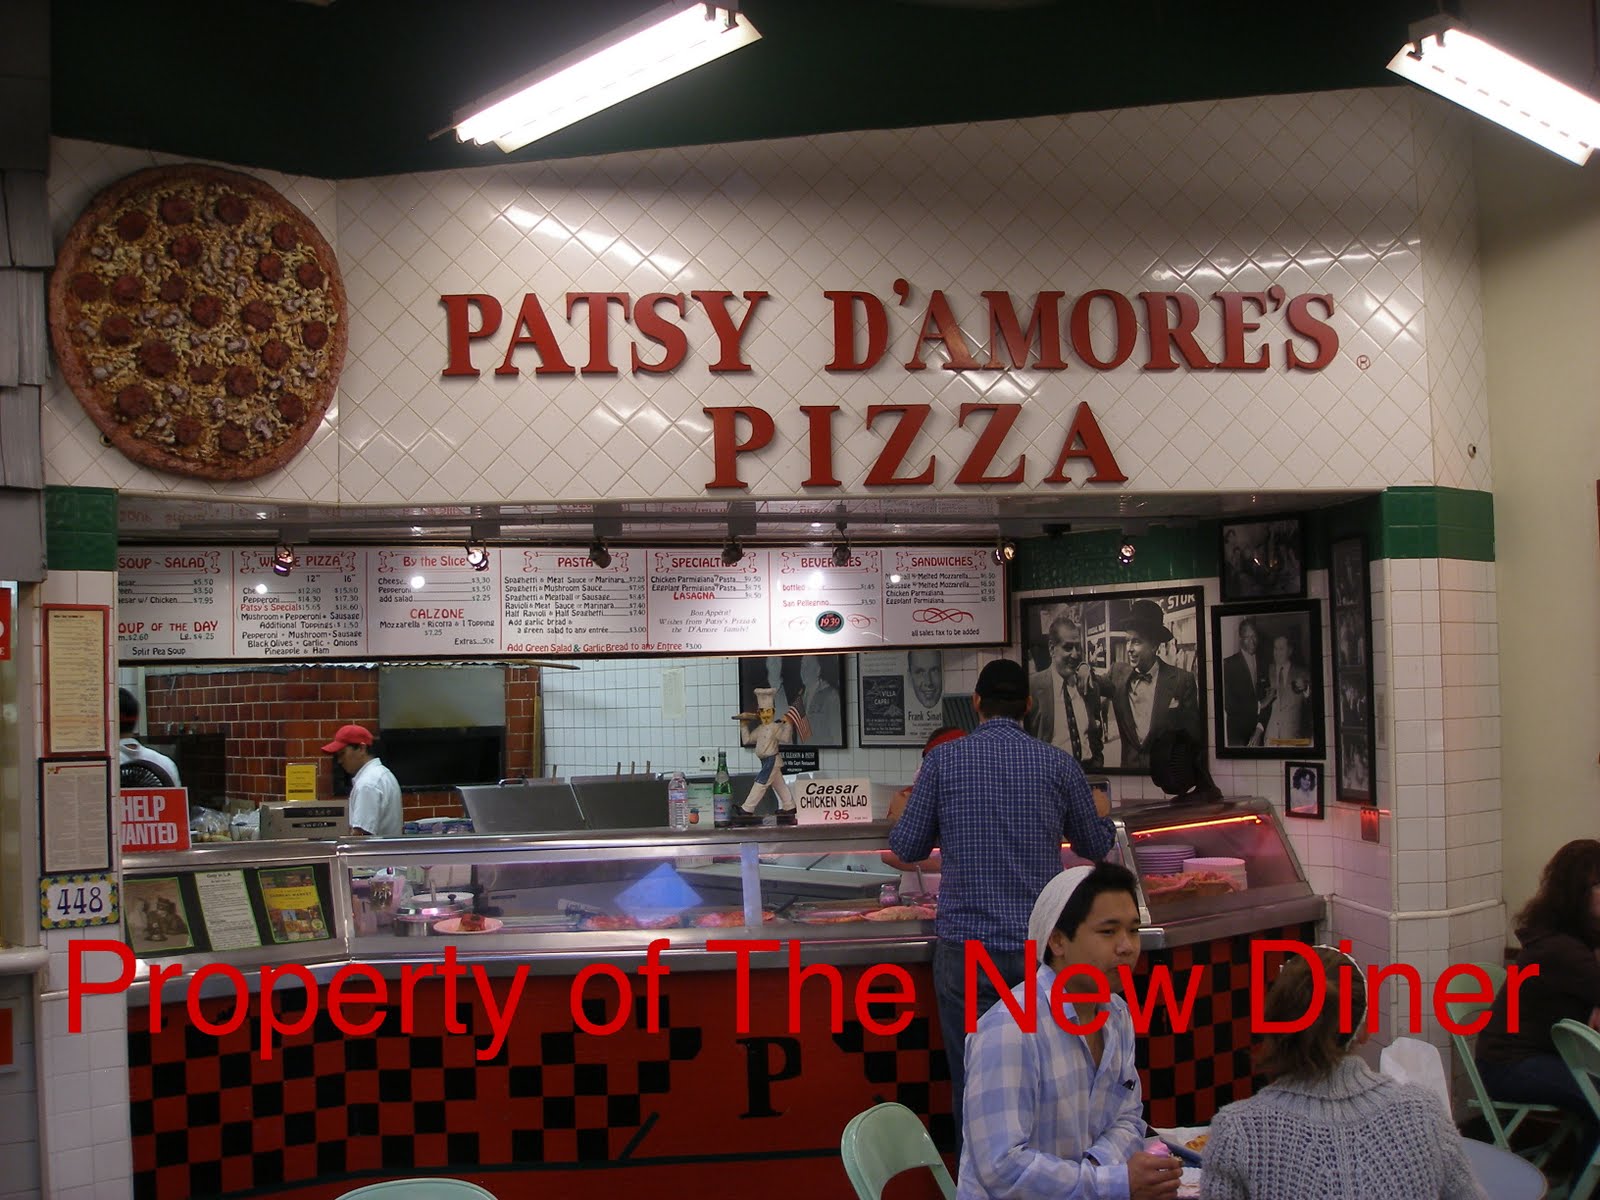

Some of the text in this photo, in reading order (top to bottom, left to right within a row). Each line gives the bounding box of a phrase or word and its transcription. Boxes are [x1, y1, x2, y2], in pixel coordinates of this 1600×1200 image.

[440, 278, 1340, 377] PATSY D'AMORE'S
[703, 401, 1129, 488] PIZZA
[118, 557, 205, 569] SOUP SALAD
[306, 555, 341, 567] PIZZA
[403, 555, 466, 567] By the Slice
[557, 557, 594, 568] PASTA
[801, 557, 862, 568] BEVERES
[911, 556, 974, 567] SANDWICHES
[378, 577, 404, 585] Cheese
[504, 576, 538, 584] Spaghetti
[547, 576, 564, 584] Meat
[567, 576, 587, 584] Sauce
[650, 575, 677, 583] Chicken
[677, 575, 715, 583] Parmigiana
[378, 586, 412, 594] Pepperoni
[504, 585, 538, 593] Spaghetti
[582, 584, 603, 592] Sauce
[651, 584, 680, 592] Eggplant
[681, 584, 715, 592] Parmigiana
[918, 581, 938, 589] Melted
[939, 581, 970, 589] Mozzarella
[581, 593, 611, 601] Sausage
[673, 592, 716, 600] LASAGNA
[910, 589, 944, 597] Parmigiana
[150, 596, 178, 604] Chicken
[242, 595, 280, 604] Pepperoni
[913, 597, 945, 605] Parmigiana
[240, 604, 269, 612] Patsy's
[270, 603, 299, 612] Special
[285, 613, 322, 621] Pepperoni
[330, 611, 360, 620] Sausage
[410, 608, 465, 619] CALZONE
[571, 609, 604, 617] Spaghetti
[118, 620, 219, 634] OUP OF THE DAY
[259, 621, 297, 629] Additional
[379, 621, 420, 629] Mozzarella
[467, 619, 495, 628] Topping
[820, 617, 840, 628] 1939
[242, 630, 362, 639] Pepperoni Mushroom Sausage
[919, 629, 935, 637] sales
[962, 628, 980, 636] added
[247, 639, 359, 648] Black Olives Garlic Onions
[507, 643, 523, 652] Add
[525, 643, 549, 652] Green
[550, 644, 572, 653] Salad
[583, 643, 605, 652] Garlic
[606, 643, 628, 652] Bread
[631, 642, 639, 651] to
[656, 642, 682, 651] Entree
[132, 646, 186, 656] Split Pea Soup
[264, 646, 330, 655] Pineapple Ham
[908, 711, 923, 721] Frank
[805, 782, 859, 795] Caesar
[800, 795, 868, 809] CHICKEN SALAD
[120, 795, 166, 822] HELP
[823, 810, 850, 820] 7.95
[57, 886, 103, 915] 448
